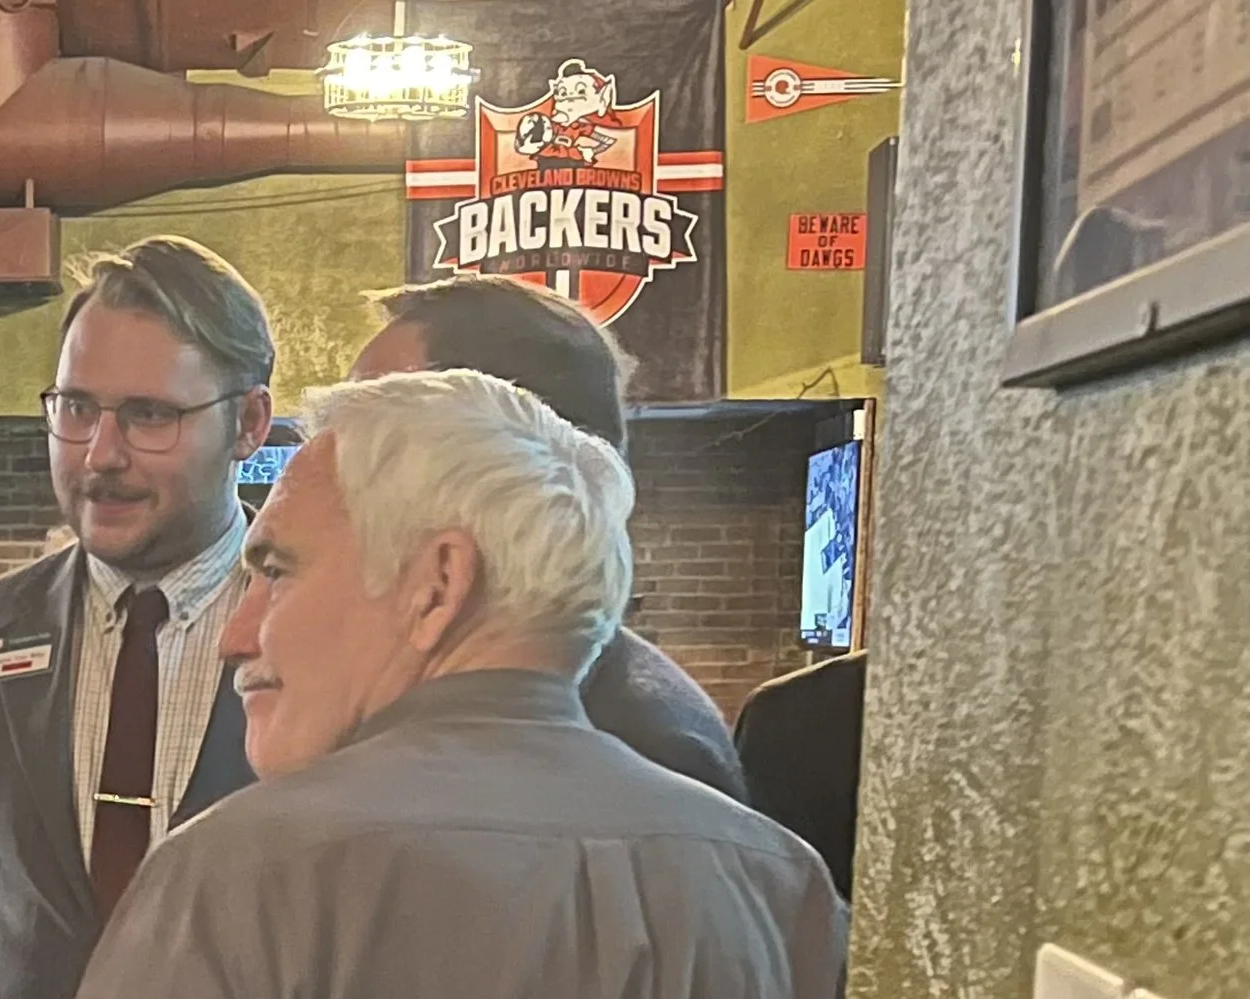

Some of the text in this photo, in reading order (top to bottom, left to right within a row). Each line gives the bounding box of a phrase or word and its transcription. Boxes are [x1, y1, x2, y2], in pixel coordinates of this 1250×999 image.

[492, 167, 641, 193] CLEVELAND BROWNS
[459, 189, 673, 266] BACKERS
[798, 215, 860, 234] BEWARE
[818, 235, 838, 248] OF
[800, 249, 854, 268] DAWGS
